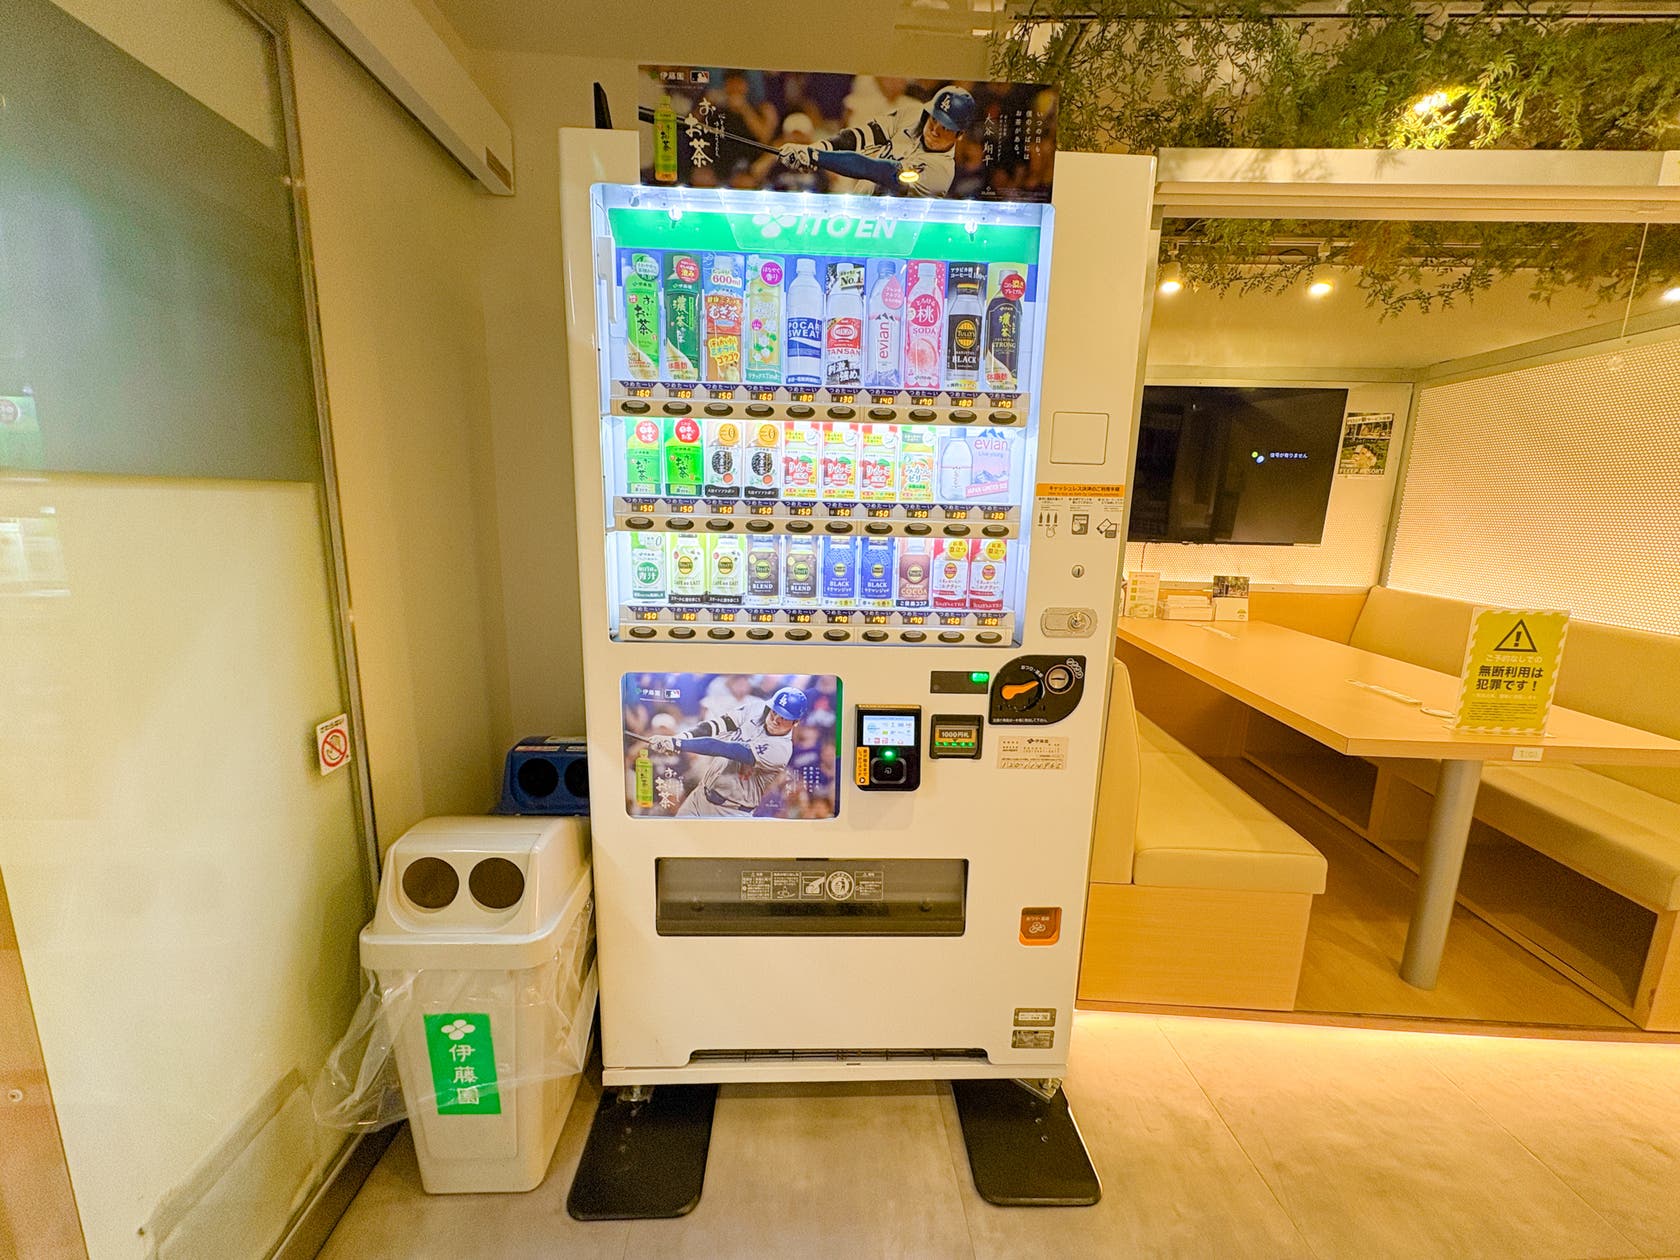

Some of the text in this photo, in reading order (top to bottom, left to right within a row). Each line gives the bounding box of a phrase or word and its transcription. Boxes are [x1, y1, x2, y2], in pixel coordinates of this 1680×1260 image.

[797, 214, 897, 239] ITO EN
[709, 304, 740, 321] むぎ茶
[916, 305, 935, 323] 桃
[912, 327, 937, 335] SODA
[879, 321, 890, 359] evian
[952, 356, 977, 364] BLACK
[974, 438, 1008, 450] evian
[1478, 665, 1544, 678] 無断利用は
[1475, 678, 1537, 692] 犯罪です！
[449, 1044, 479, 1105] 伊藤園
